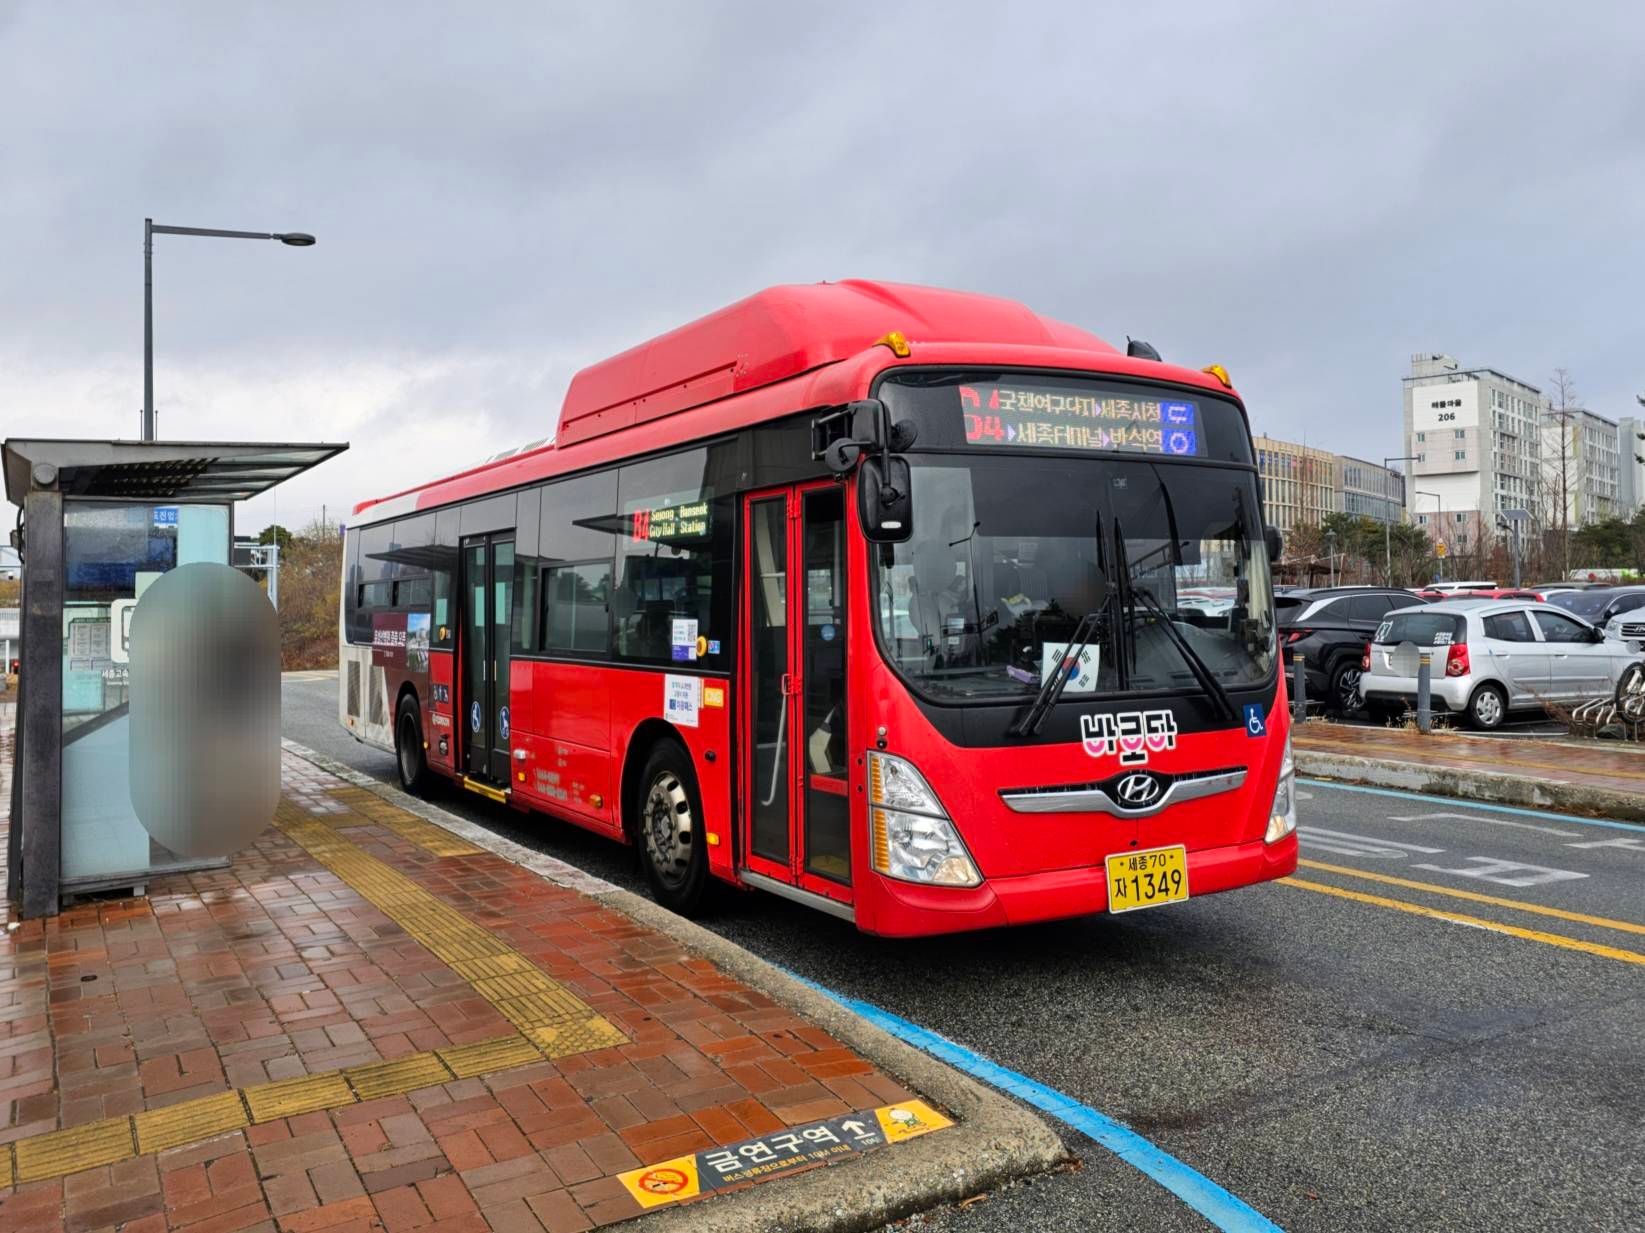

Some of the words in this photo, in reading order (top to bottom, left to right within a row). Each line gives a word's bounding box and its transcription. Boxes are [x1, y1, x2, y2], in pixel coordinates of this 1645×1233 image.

[1438, 412, 1456, 422] 206
[1081, 710, 1177, 766] 바로타
[704, 1125, 841, 1173] 금연구역
